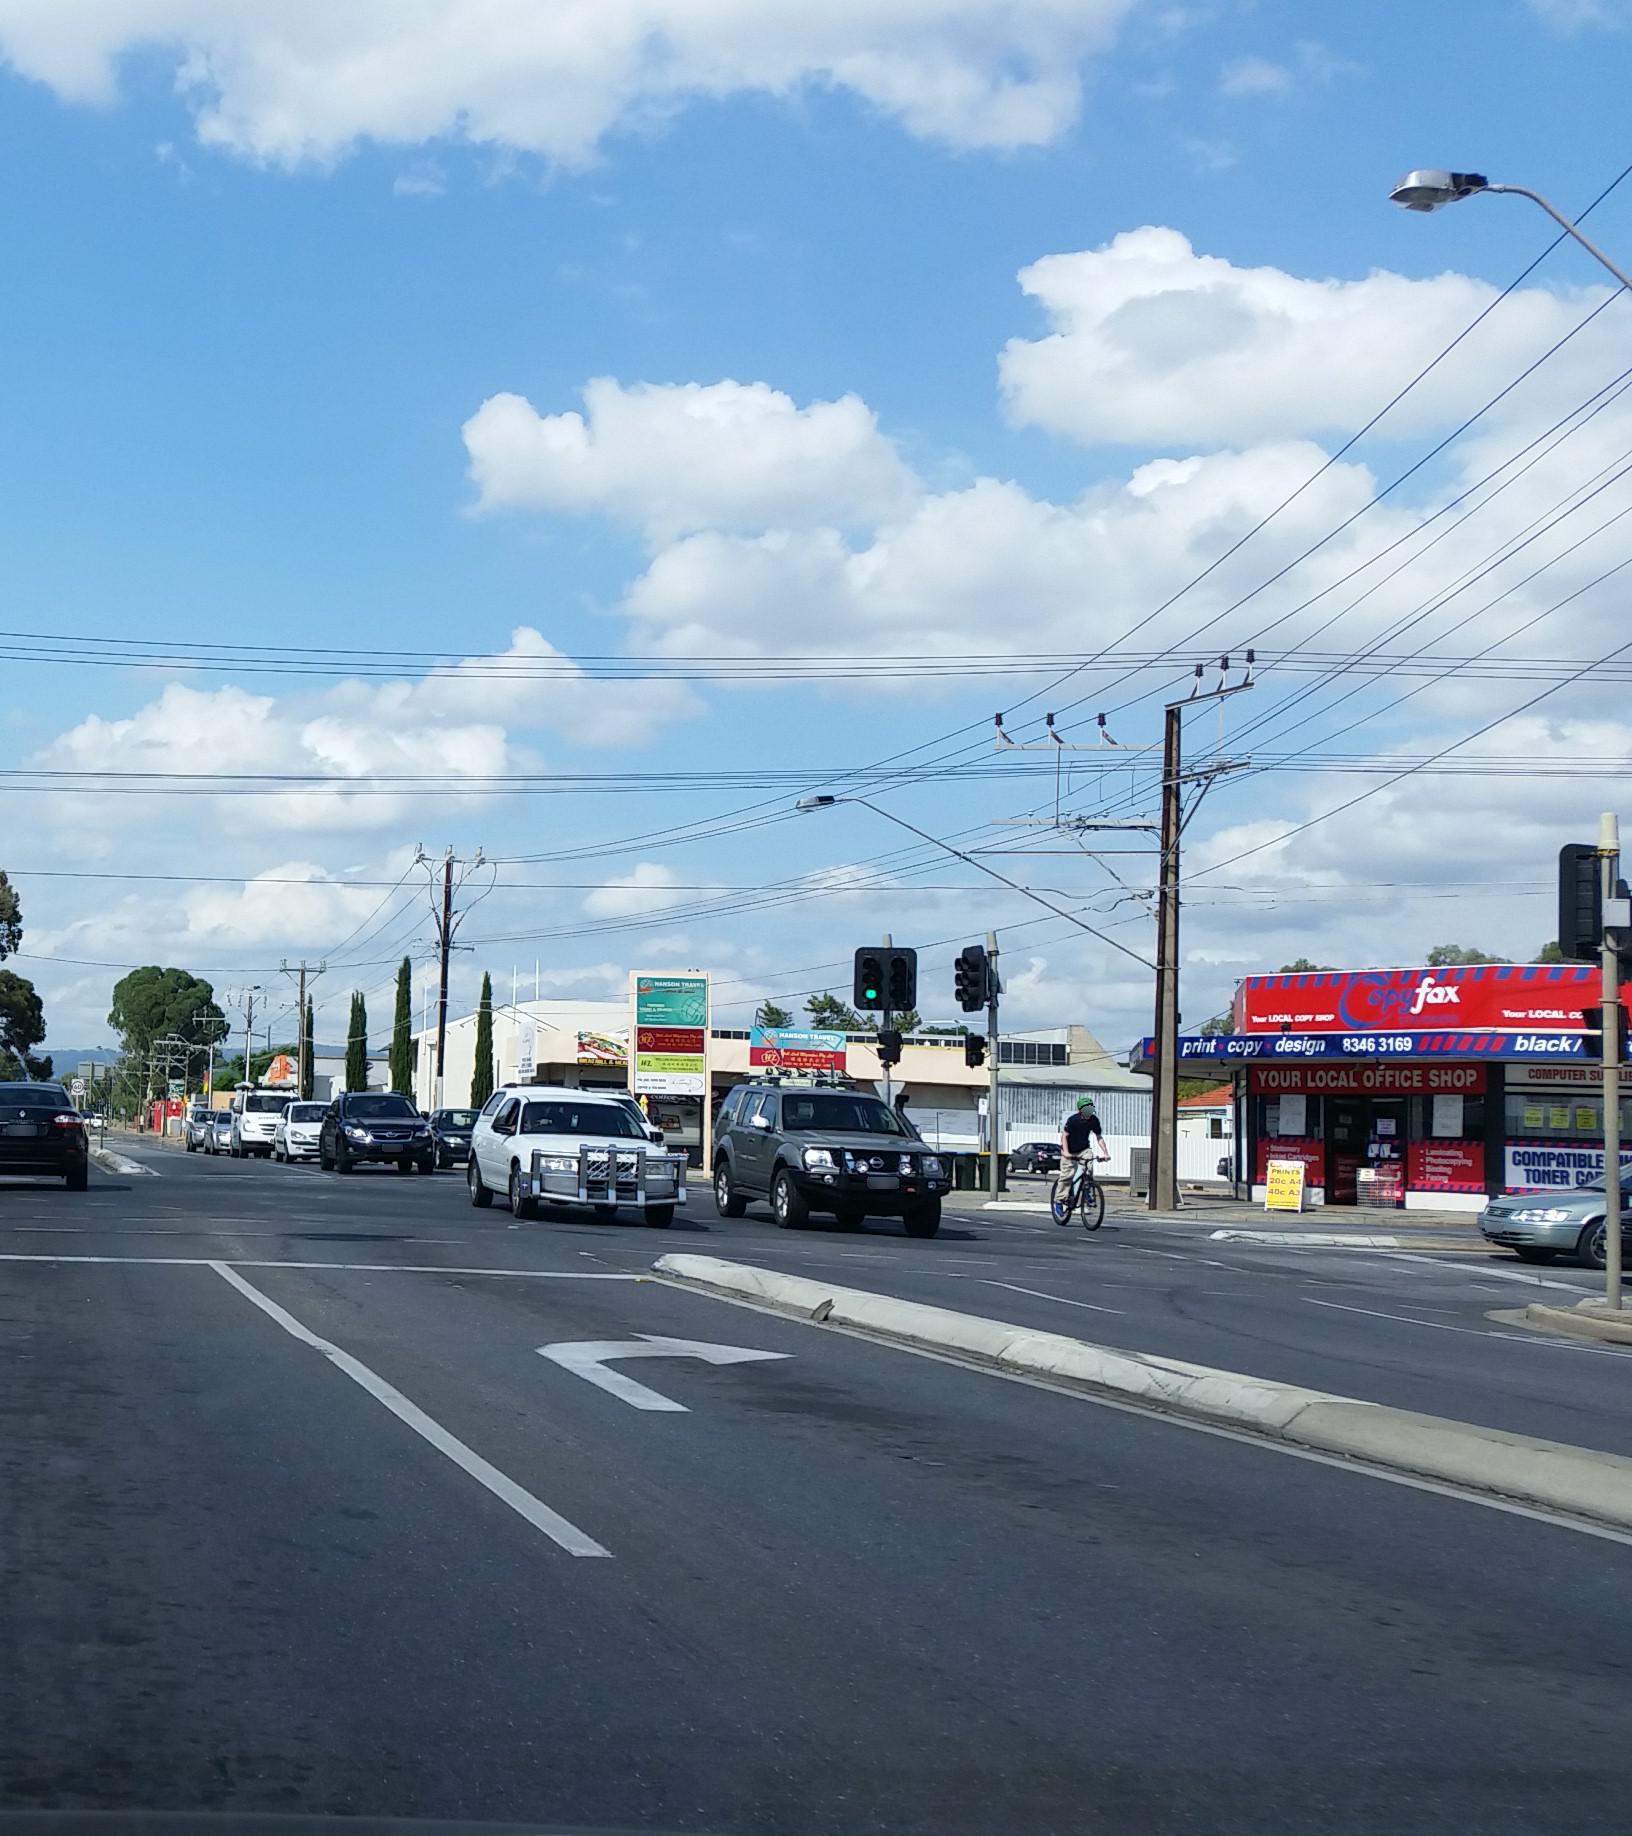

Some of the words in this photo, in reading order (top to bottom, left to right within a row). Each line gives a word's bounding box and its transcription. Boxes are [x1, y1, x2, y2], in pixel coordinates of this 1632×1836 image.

[1268, 1014, 1293, 1022] LOCAL
[1295, 1014, 1313, 1022] COPY
[1315, 1014, 1334, 1022] SHOP
[1502, 1010, 1527, 1018] Your
[1527, 1009, 1566, 1019] LOCAL
[1182, 1038, 1216, 1056] print
[1228, 1039, 1263, 1055] copy
[1275, 1037, 1325, 1055] design
[1343, 1037, 1375, 1052] 8346
[1379, 1037, 1412, 1051] 3169
[1257, 1071, 1301, 1088] YOUR
[1307, 1070, 1358, 1088] LOCAL
[1363, 1069, 1422, 1087] OFFICE
[1428, 1069, 1477, 1087] SHOP
[1528, 1068, 1586, 1081] COMPUTER
[1590, 1070, 1632, 1082] SULIE
[1288, 1153, 1319, 1162] Cartridges
[1426, 1148, 1464, 1158] Laminating
[1426, 1157, 1472, 1167] Photocopying
[1512, 1150, 1604, 1169] COMPATIBLE
[1426, 1165, 1452, 1175] Binding
[1426, 1174, 1448, 1183] Faxing
[1523, 1168, 1570, 1185] TONER
[1268, 1188, 1286, 1196] 40c
